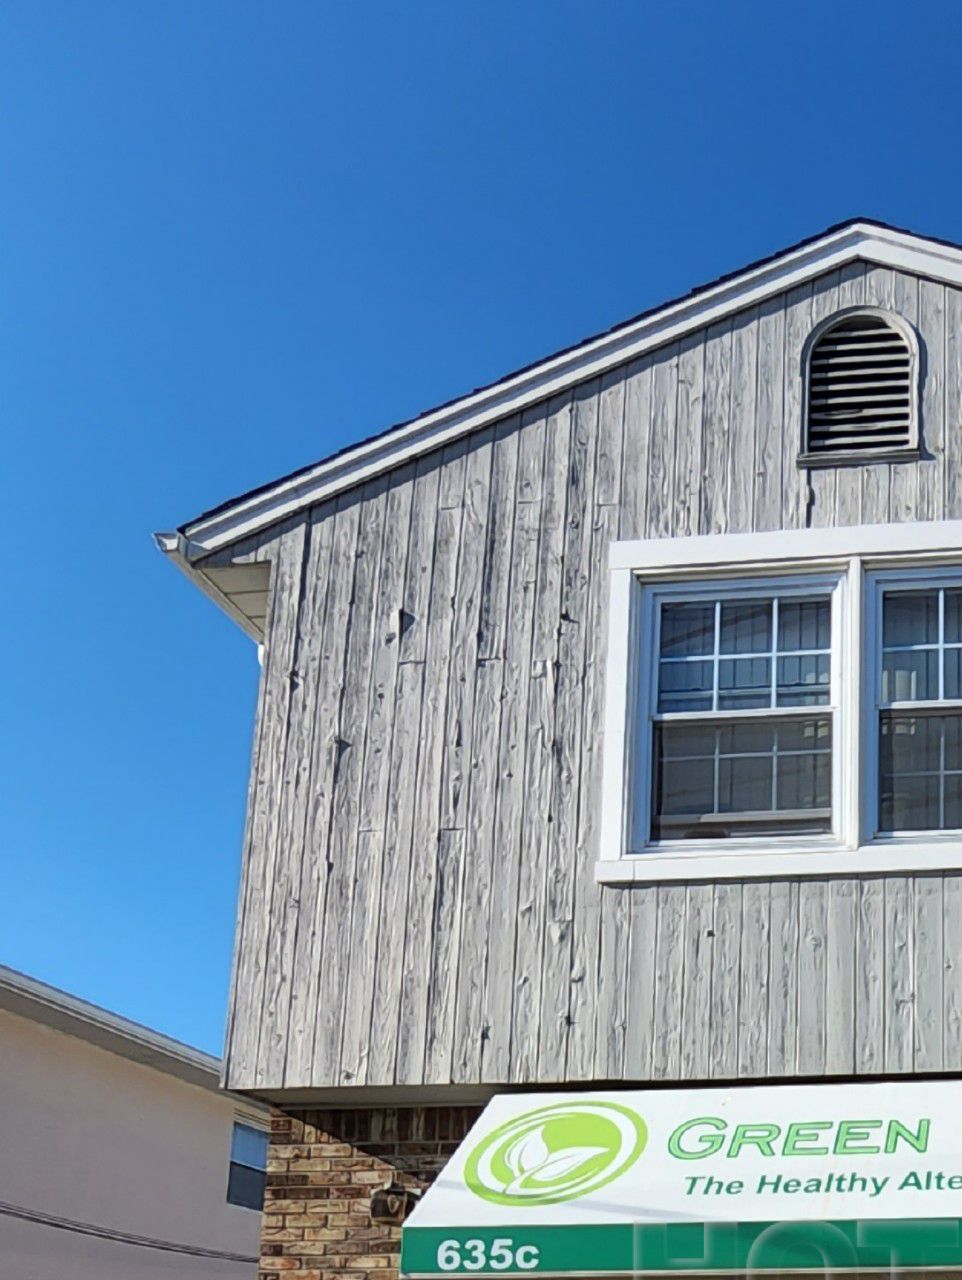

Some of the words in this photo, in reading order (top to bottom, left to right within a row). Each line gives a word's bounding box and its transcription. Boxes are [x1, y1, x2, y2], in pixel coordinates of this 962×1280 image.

[684, 1175, 744, 1196] The
[757, 1172, 885, 1197] Healthy
[437, 1237, 540, 1271] 635c
